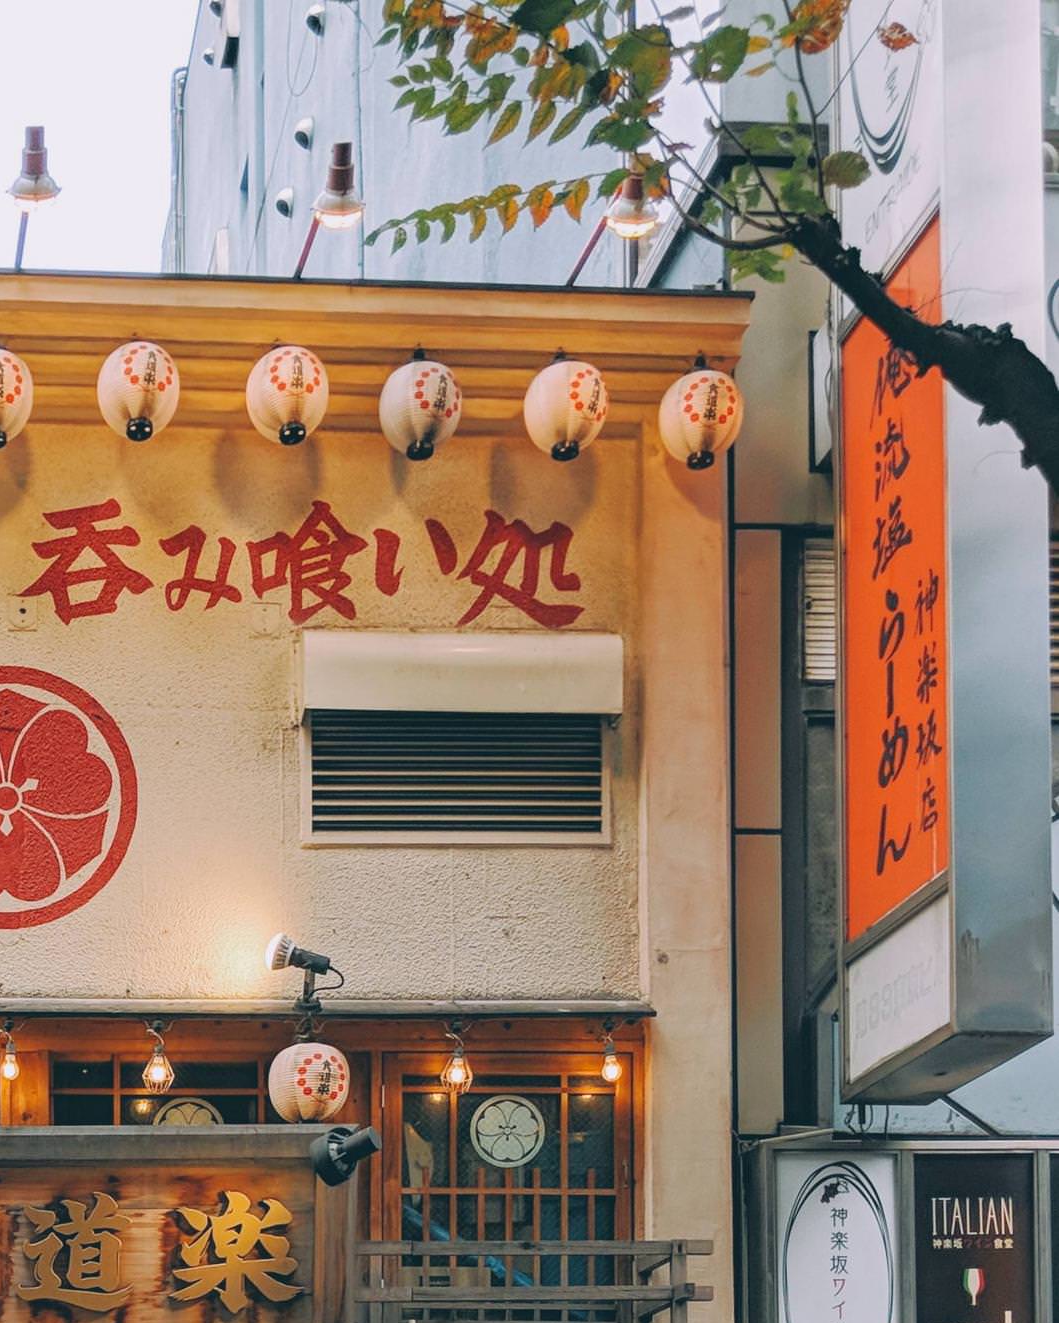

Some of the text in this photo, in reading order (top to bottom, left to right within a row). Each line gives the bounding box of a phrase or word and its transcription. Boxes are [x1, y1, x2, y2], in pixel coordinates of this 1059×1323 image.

[21, 497, 585, 630] 呑み喰い処
[913, 569, 943, 833] 神楽坂店
[931, 1197, 1014, 1236] ITALIAN
